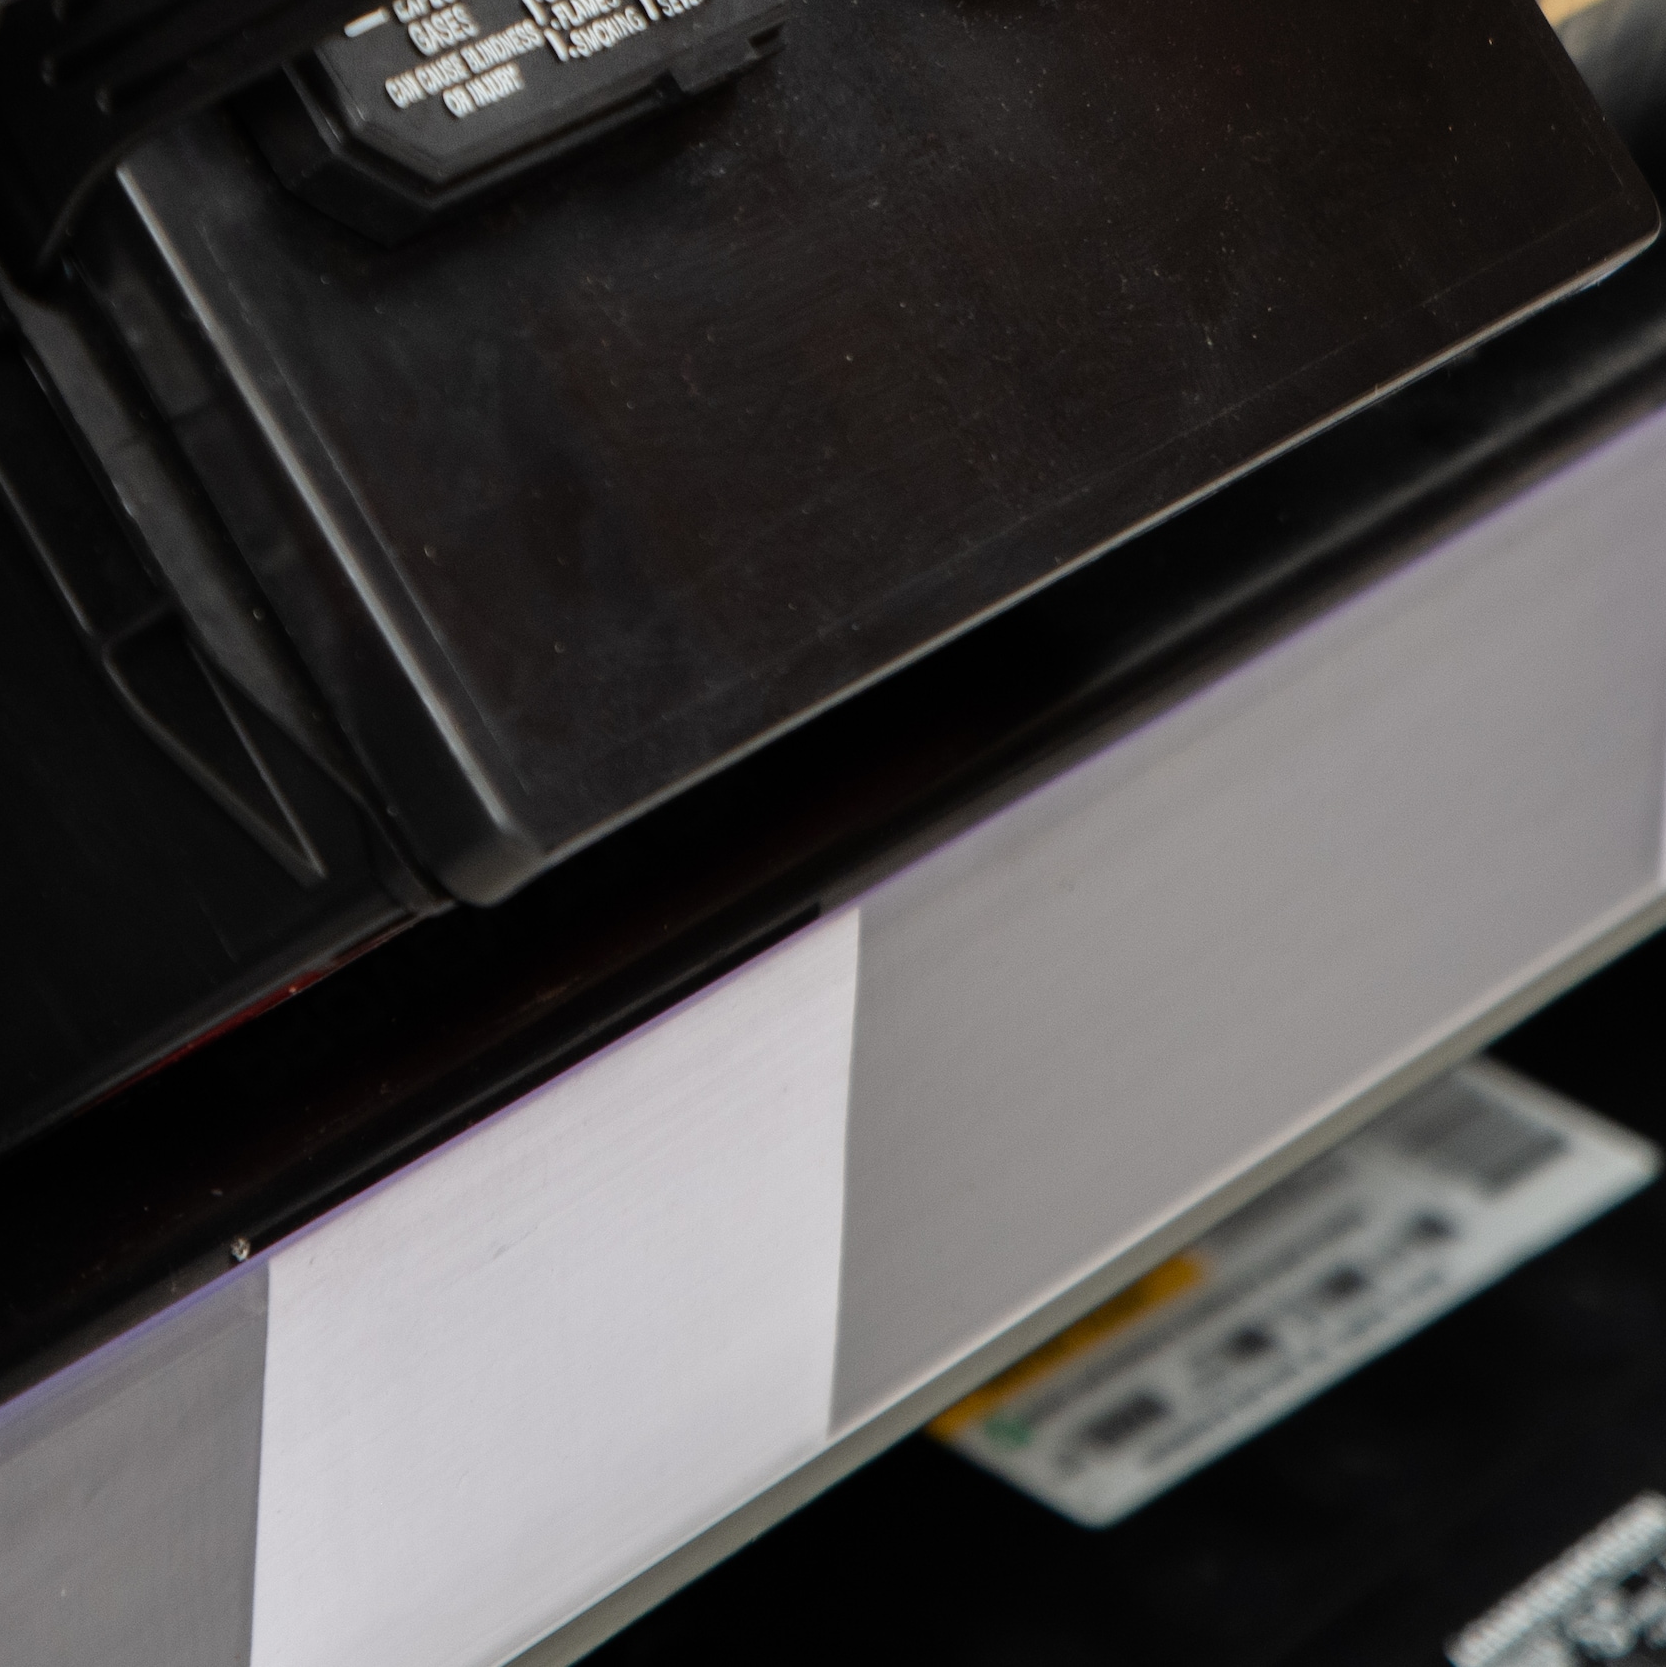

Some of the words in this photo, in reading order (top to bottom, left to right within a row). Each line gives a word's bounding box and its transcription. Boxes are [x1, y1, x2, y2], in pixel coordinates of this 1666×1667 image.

[408, 3, 480, 56] GASES
[570, 5, 648, 57] SMOKING
[385, 70, 427, 109] CAN
[414, 51, 471, 95] CAUSE
[460, 18, 545, 74] BLINDNESS
[442, 85, 476, 118] OR
[465, 62, 525, 107] INJURY
